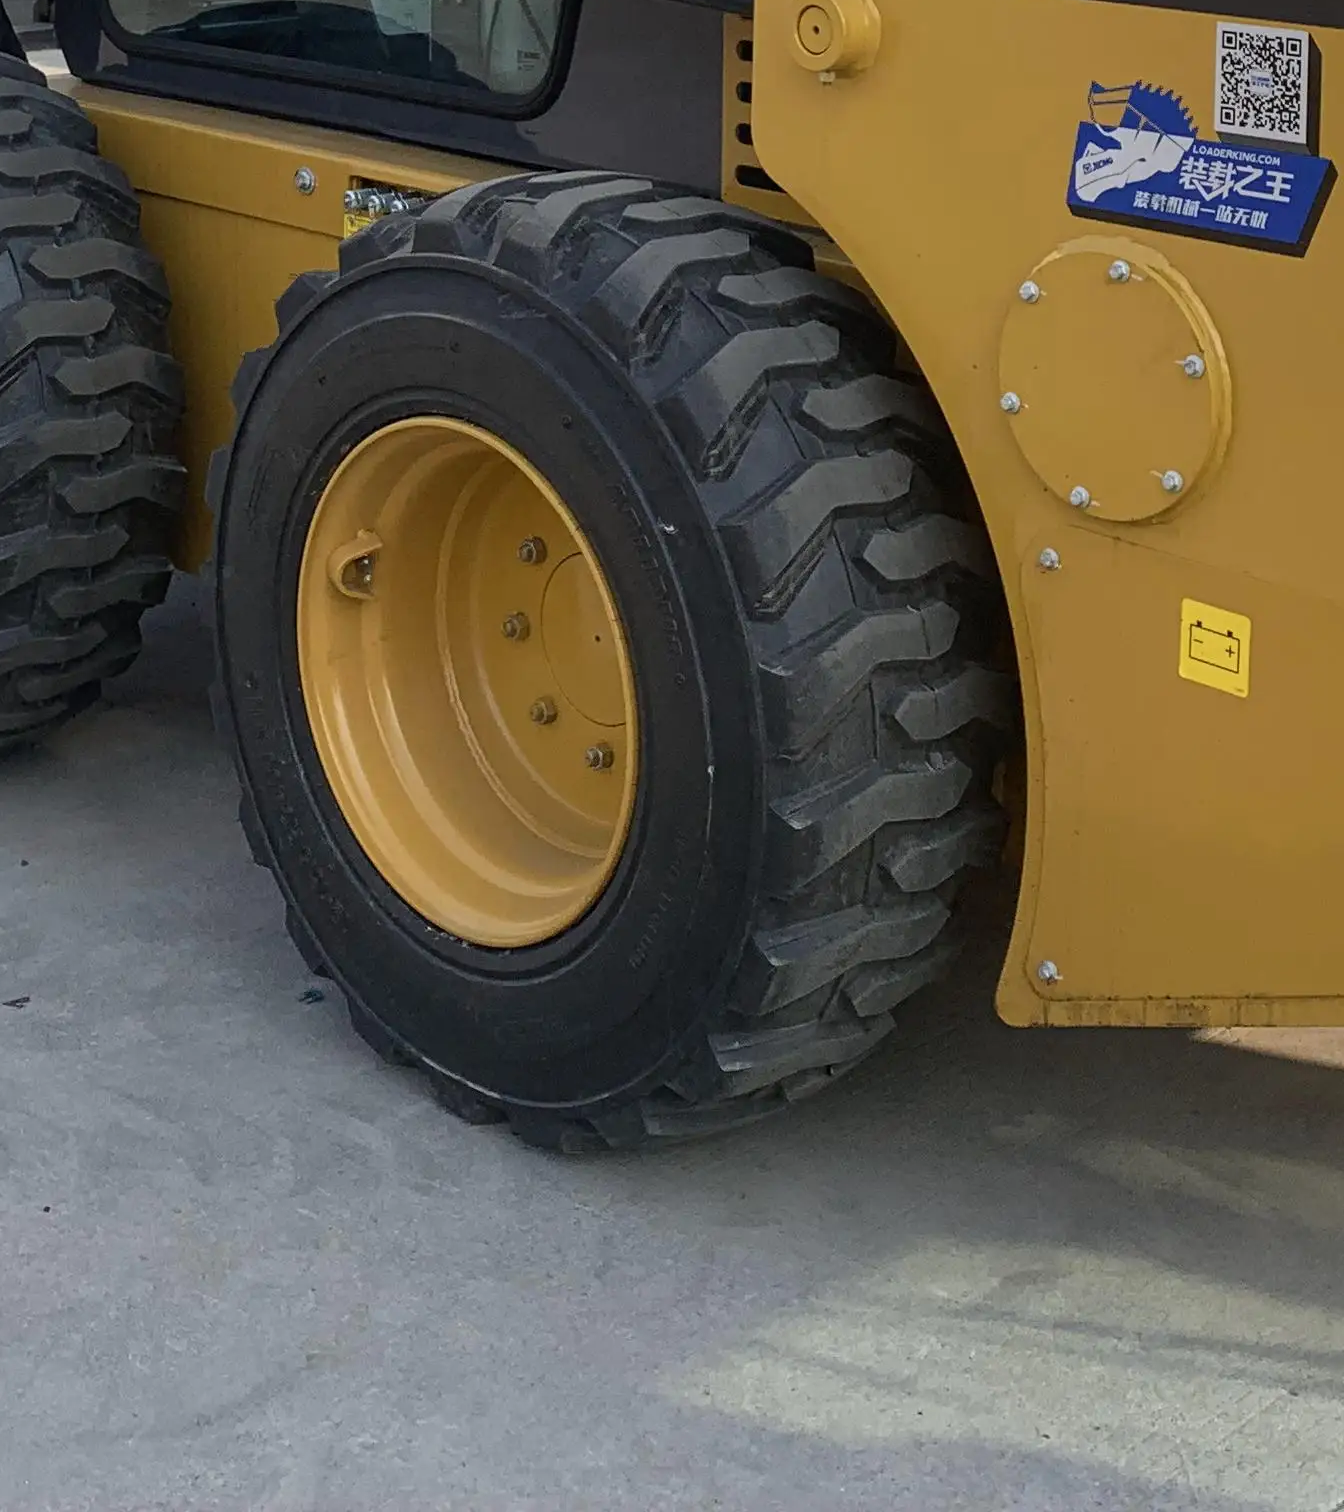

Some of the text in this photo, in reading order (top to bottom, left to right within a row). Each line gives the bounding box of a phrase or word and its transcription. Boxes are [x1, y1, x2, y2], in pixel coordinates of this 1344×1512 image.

[1193, 145, 1281, 166] LOADERKING.COM
[1178, 156, 1294, 203] 装载之王
